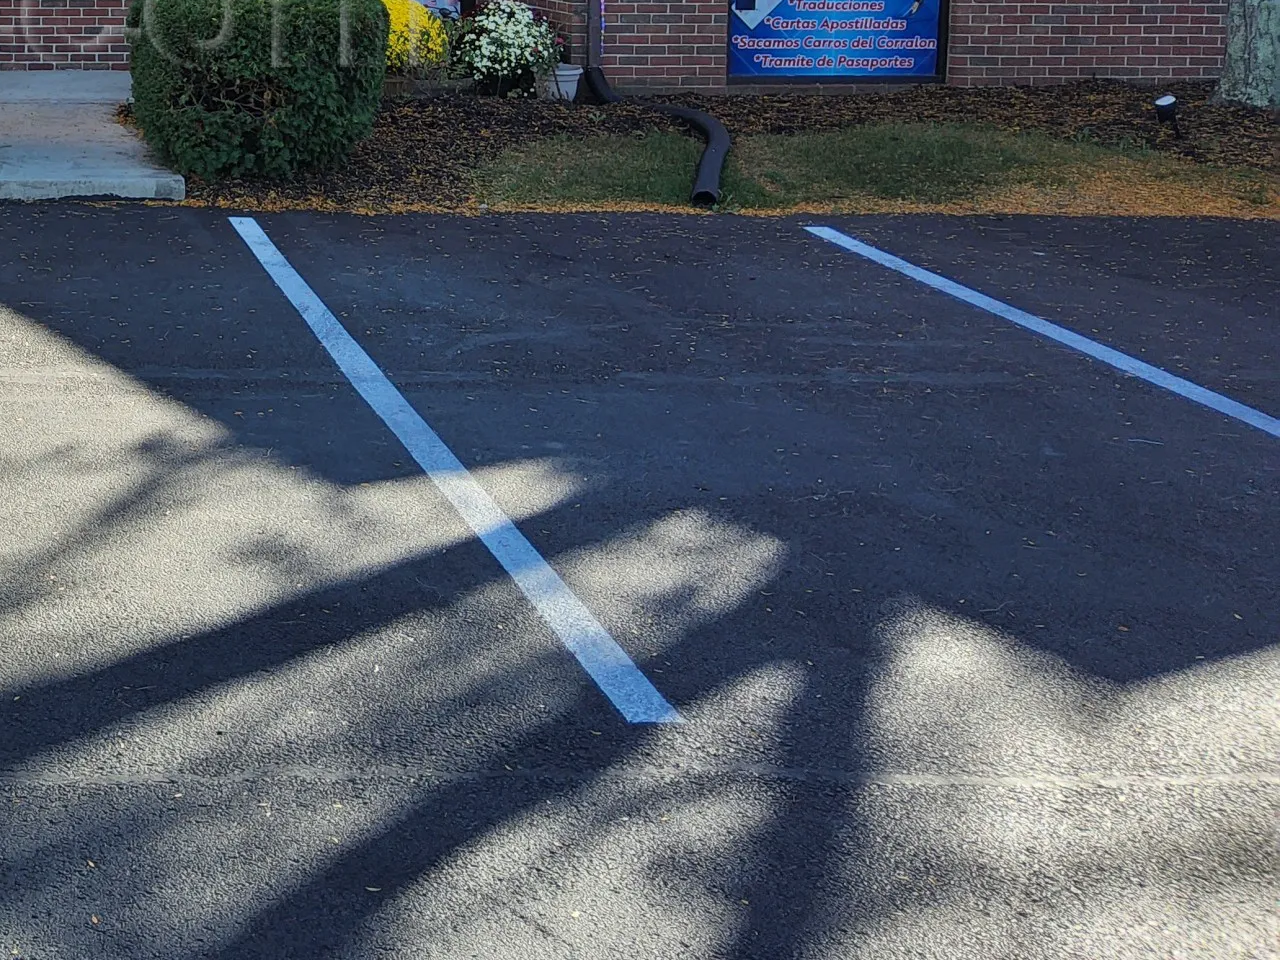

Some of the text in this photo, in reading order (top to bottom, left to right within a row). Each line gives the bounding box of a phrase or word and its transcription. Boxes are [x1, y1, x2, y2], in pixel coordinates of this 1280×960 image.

[820, 16, 907, 33] Apostilladas
[803, 36, 848, 49] Carros
[851, 35, 873, 49] del
[876, 35, 937, 49] Corralon
[816, 54, 834, 68] de
[837, 55, 914, 71] Pasaportes
